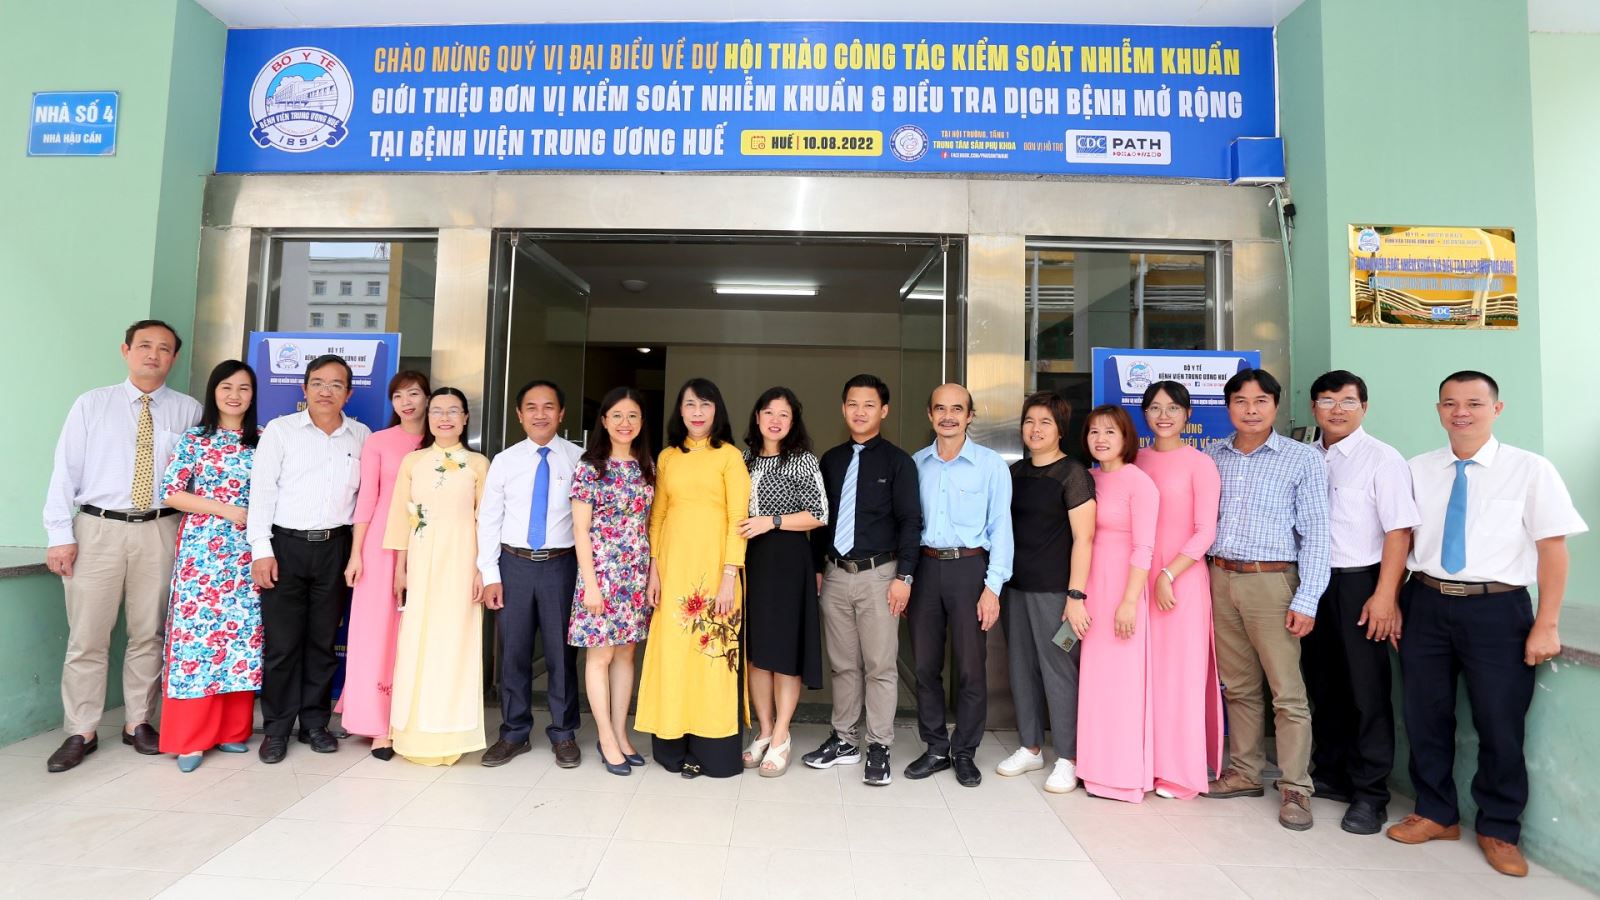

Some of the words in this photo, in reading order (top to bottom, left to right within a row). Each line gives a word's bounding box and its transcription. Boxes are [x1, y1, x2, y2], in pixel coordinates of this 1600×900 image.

[302, 52, 311, 61] Y
[374, 43, 425, 73] CHÀO
[431, 40, 490, 72] MỪNG
[497, 41, 537, 72] QUÝ
[543, 45, 564, 73] VỊ
[569, 45, 604, 73] ĐẠI
[609, 36, 654, 69] BIỂU
[661, 37, 686, 69] VỀ
[691, 42, 719, 73] DỰ
[724, 39, 763, 73] HỘI
[768, 37, 828, 70] THẢO
[834, 38, 896, 70] CÔNG
[902, 39, 945, 70] TÁC
[951, 36, 1009, 71] KIỂM
[1015, 41, 1074, 72] SOÁT
[1080, 38, 1155, 74] NHIỄM
[1161, 40, 1240, 75] KHUẨN
[371, 83, 417, 114] GIỚI
[422, 83, 484, 117] THIỆU
[489, 84, 536, 113] ĐƠN
[543, 86, 566, 116] VỊ
[572, 78, 629, 113] KIỂM
[636, 80, 695, 112] SOÁT
[701, 76, 777, 112] NHIỄM
[784, 77, 864, 112] KHUẨN
[871, 85, 886, 112] &
[892, 78, 944, 113] ĐIỀU
[950, 87, 997, 113] TRA
[1004, 87, 1060, 118] DỊCH
[1066, 84, 1127, 119] BỆNH
[1133, 83, 1171, 117] MỞ
[1178, 86, 1243, 121] RỘNG
[35, 101, 70, 123] NHÀ
[75, 99, 100, 123] SỐ
[103, 105, 114, 123] 4
[279, 135, 319, 146] 1894
[369, 130, 404, 161] TẠI
[409, 126, 467, 161] BỆNH
[473, 125, 525, 160] VIỆN
[530, 129, 606, 156] TRUNG
[612, 127, 676, 155] ƯƠNG
[682, 121, 730, 155] HUẾ
[771, 132, 794, 149] HUẾ
[803, 136, 874, 150] 10.08.2022
[933, 140, 954, 149] TRUNG
[999, 141, 1016, 150] KHOA
[1077, 136, 1107, 149] CDC
[1112, 138, 1162, 150] PATH
[1433, 307, 1450, 315] CDC
